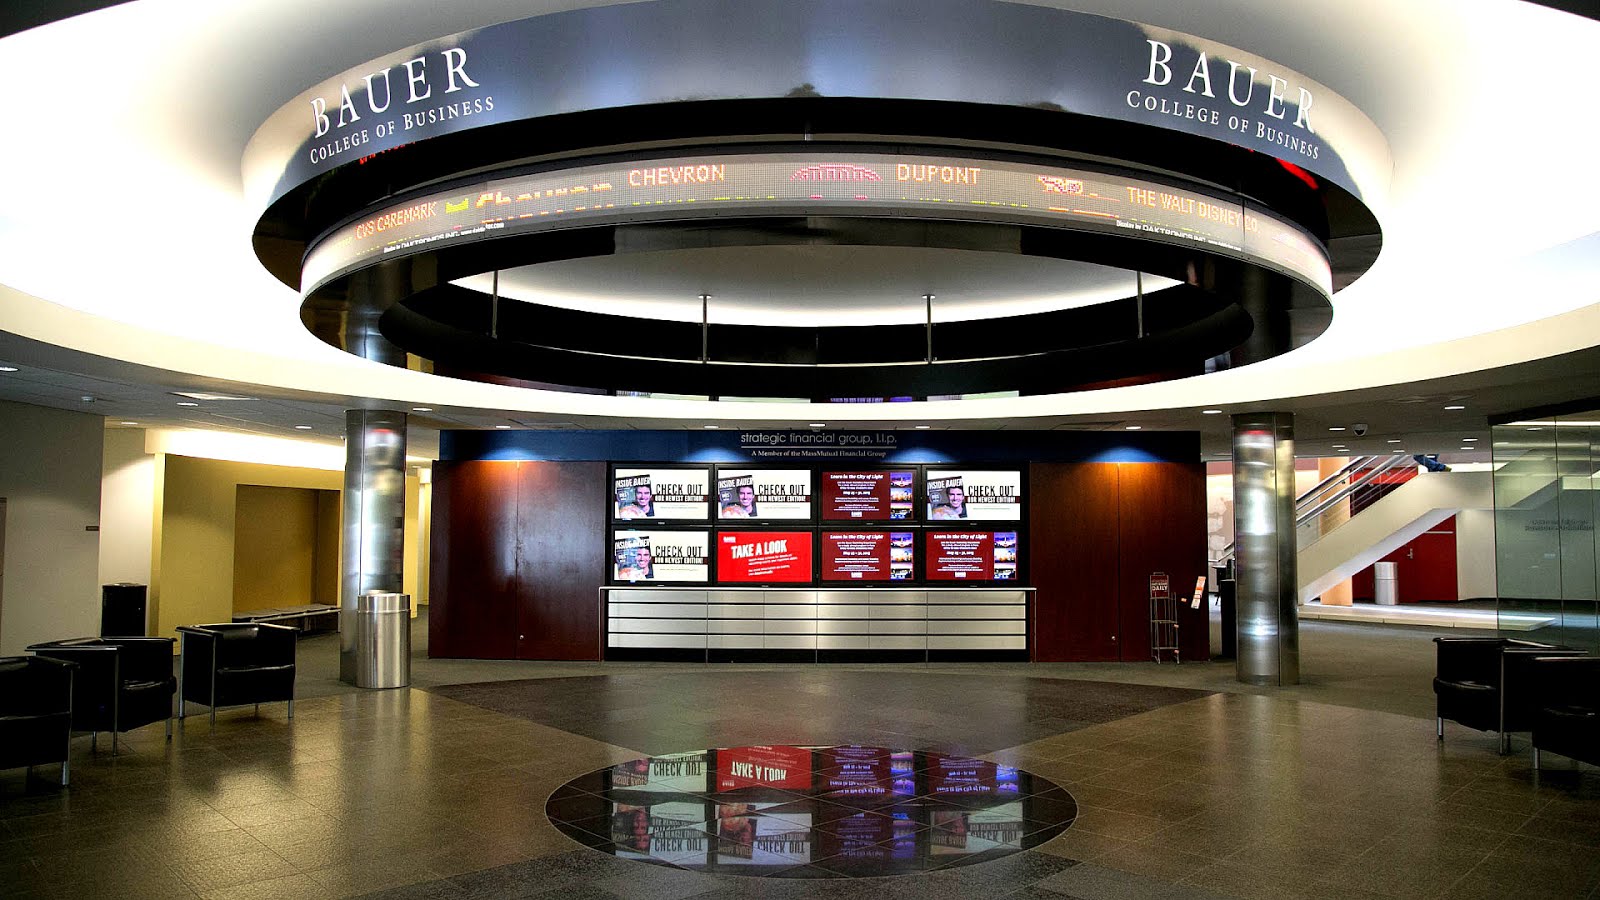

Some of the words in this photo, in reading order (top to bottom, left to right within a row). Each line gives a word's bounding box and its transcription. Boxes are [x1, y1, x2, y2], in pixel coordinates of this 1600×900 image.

[310, 47, 480, 139] BAUER
[1142, 39, 1315, 134] BAUER
[310, 129, 369, 164] COLLEGE
[376, 121, 395, 138] OF
[403, 96, 494, 130] BUSINESS
[1126, 90, 1219, 125] COLLEGE
[1228, 115, 1249, 133] OF
[1256, 121, 1319, 160] BUSINESS
[628, 164, 726, 187] CHEVRON
[896, 163, 981, 184] DUPONT
[1126, 186, 1156, 207] THE
[1160, 192, 1195, 214] WALT
[1196, 201, 1242, 227] DISNEY
[355, 220, 375, 240] CVS
[376, 201, 437, 232] CAREMARK
[741, 433, 786, 445] strategic
[790, 433, 835, 443] financial
[838, 434, 873, 445] group,
[867, 450, 886, 458] Group
[656, 484, 683, 495] CHECK
[687, 484, 703, 495] OUT
[758, 484, 786, 496] CHECK
[790, 484, 805, 496] OUT
[927, 480, 945, 489] INSIDE
[968, 486, 995, 497] CHECK
[1000, 486, 1015, 497] OUT
[656, 546, 683, 557] CHECK
[687, 546, 703, 557] OUT
[731, 544, 754, 559] TAKE
[755, 542, 762, 556] A
[764, 540, 788, 555] LOOK
